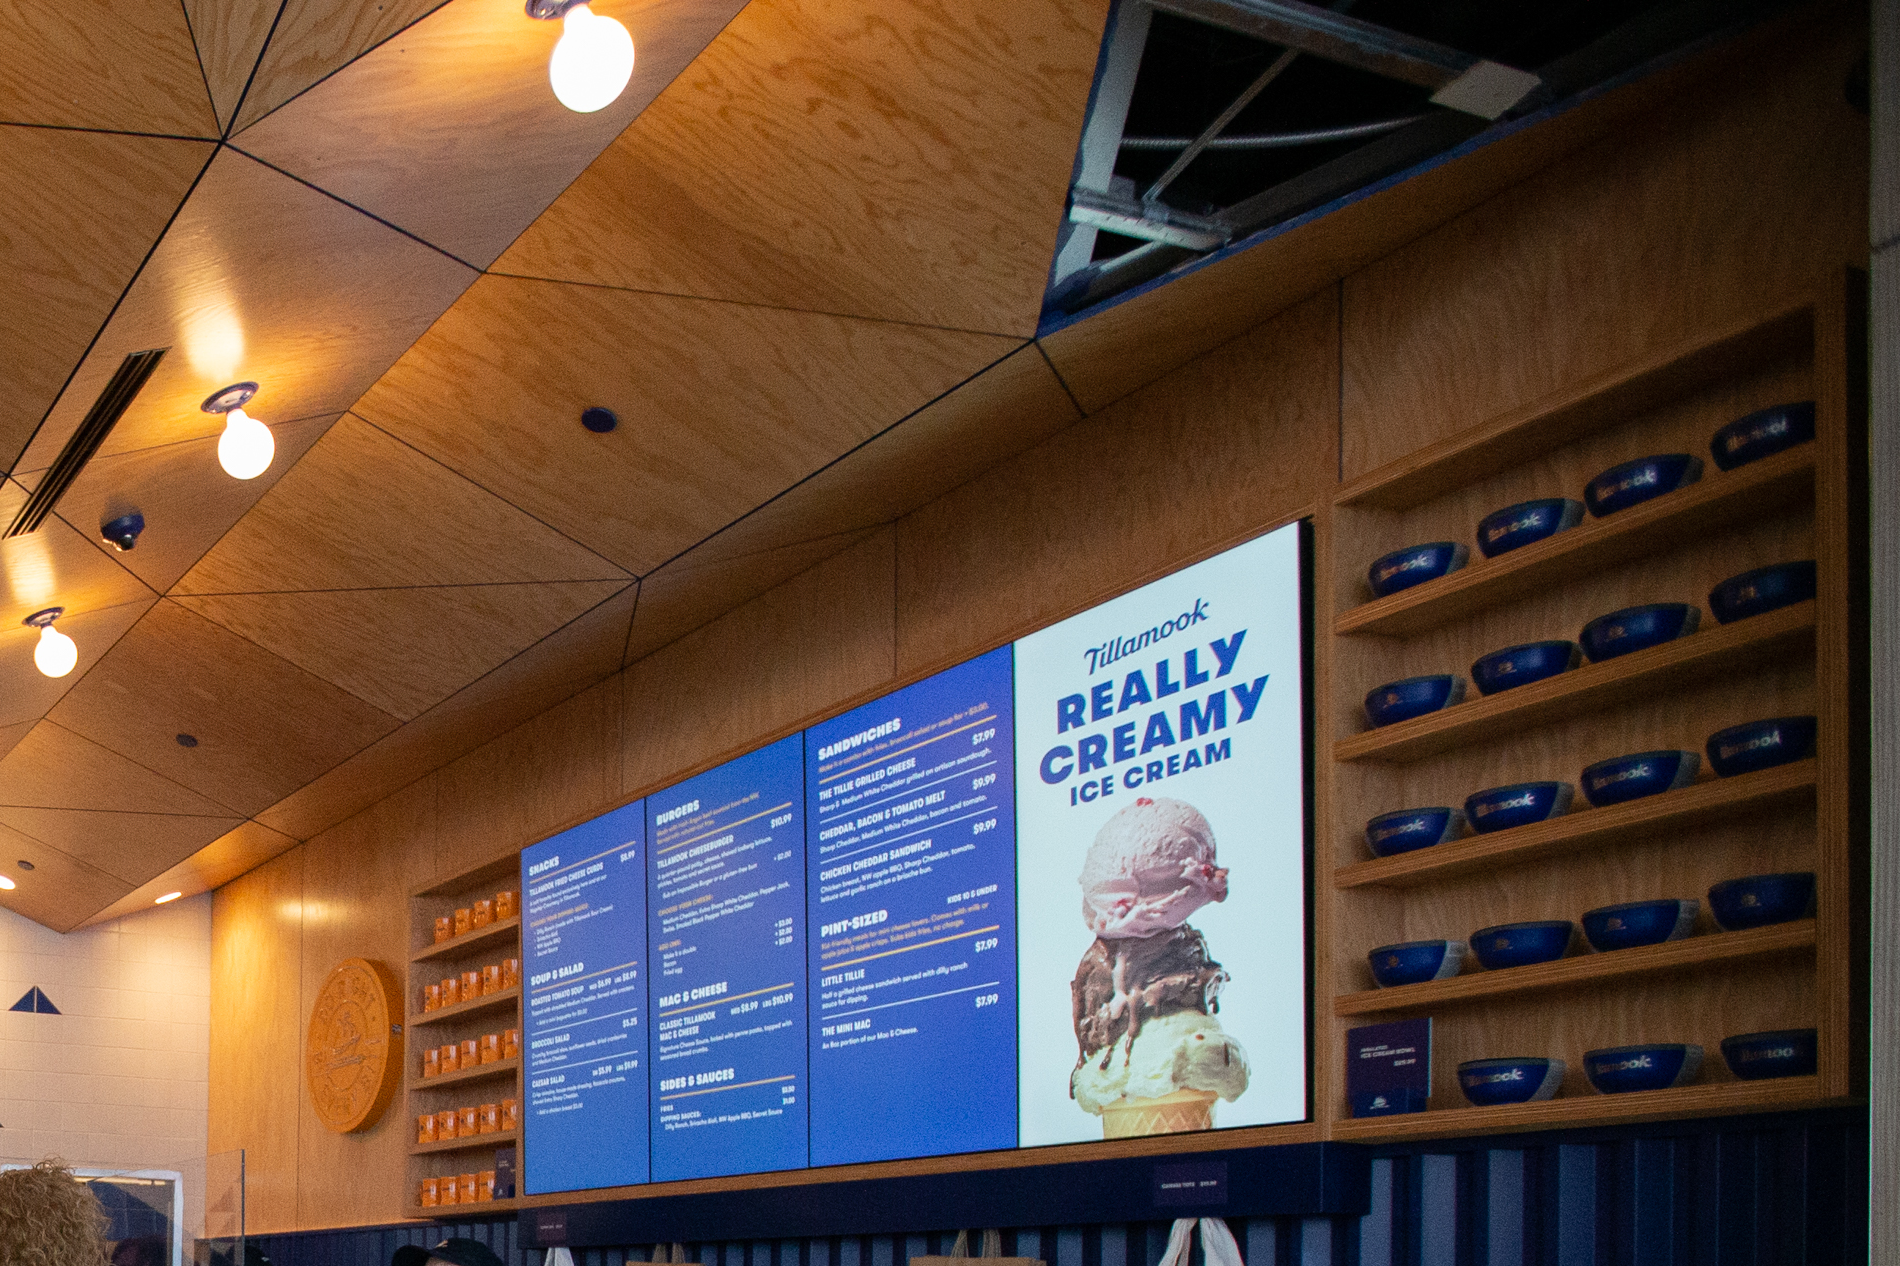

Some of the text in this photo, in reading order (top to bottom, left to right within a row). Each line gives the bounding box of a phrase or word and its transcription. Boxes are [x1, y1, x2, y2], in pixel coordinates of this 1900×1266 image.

[1084, 598, 1209, 676] Tillamook
[1057, 628, 1248, 735] REALLY
[819, 716, 900, 761] SANDWICHES
[973, 726, 995, 746] $7.99
[1039, 673, 1270, 784] CREAMY
[819, 756, 915, 802] THE TILLIE GRILLED CHEESE
[973, 772, 995, 791] $9.99
[1070, 737, 1231, 807] ICE CREAM
[657, 798, 698, 826] BURGERS
[857, 810, 883, 830] BACON
[892, 796, 924, 818] TOMATO
[925, 789, 945, 807] MELT
[973, 817, 996, 836] $9.99
[529, 855, 558, 876] SNACKS
[820, 837, 931, 883] CHICKEN CHEDDAR SANDWICH
[947, 893, 961, 904] KIDS
[976, 883, 997, 896] UNDER
[821, 908, 887, 938] PINT-SIZED
[975, 936, 997, 953] $7.99
[531, 971, 550, 986] SOUP
[559, 961, 583, 978] SALAD
[821, 968, 864, 988] LITTLE TILLIE
[659, 992, 680, 1008] MAC
[691, 981, 727, 1000] CHEESE
[976, 992, 998, 1008] $7.99
[822, 1018, 870, 1037] THE MINI MAC
[660, 1076, 686, 1091] SIDES
[696, 1068, 734, 1085] SAUCES
